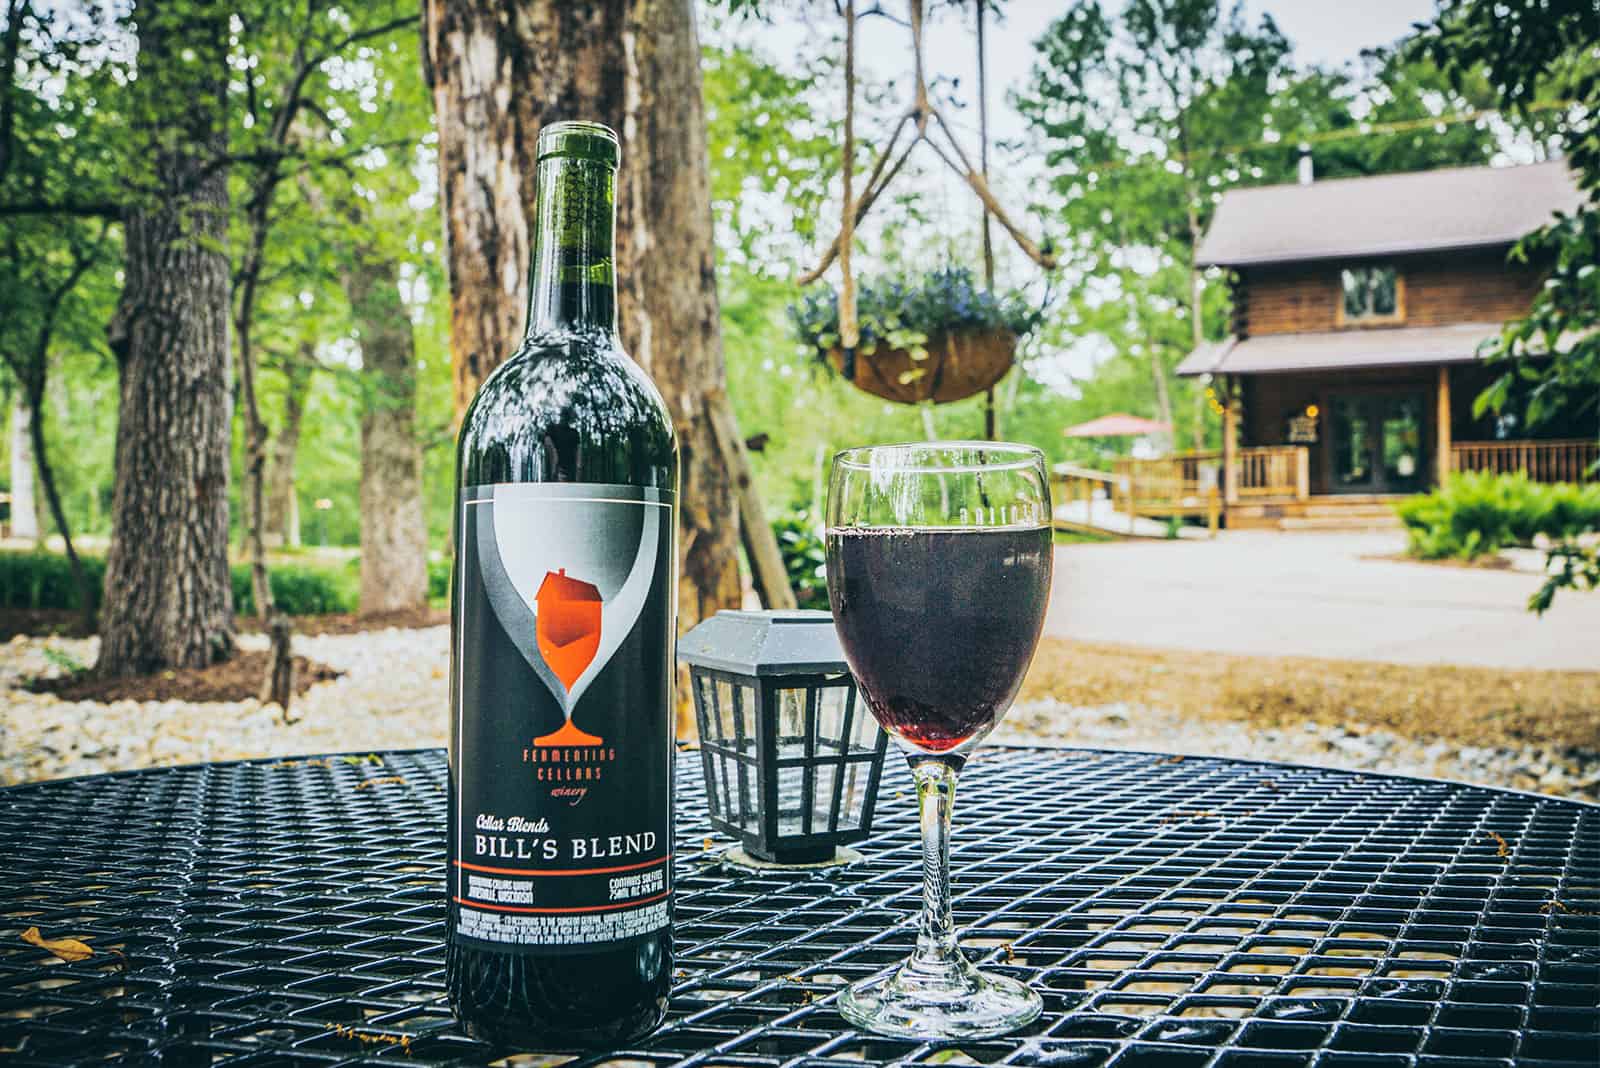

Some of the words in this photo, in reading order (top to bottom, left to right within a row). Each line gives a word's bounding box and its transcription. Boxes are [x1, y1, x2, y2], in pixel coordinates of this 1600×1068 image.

[522, 748, 616, 762] FERMENTING
[537, 767, 601, 781] CELLARS
[551, 785, 588, 806] winery
[476, 814, 504, 830] Cellar
[506, 816, 550, 833] Blends
[474, 835, 558, 859] BILL'S
[571, 831, 657, 859] BLEND
